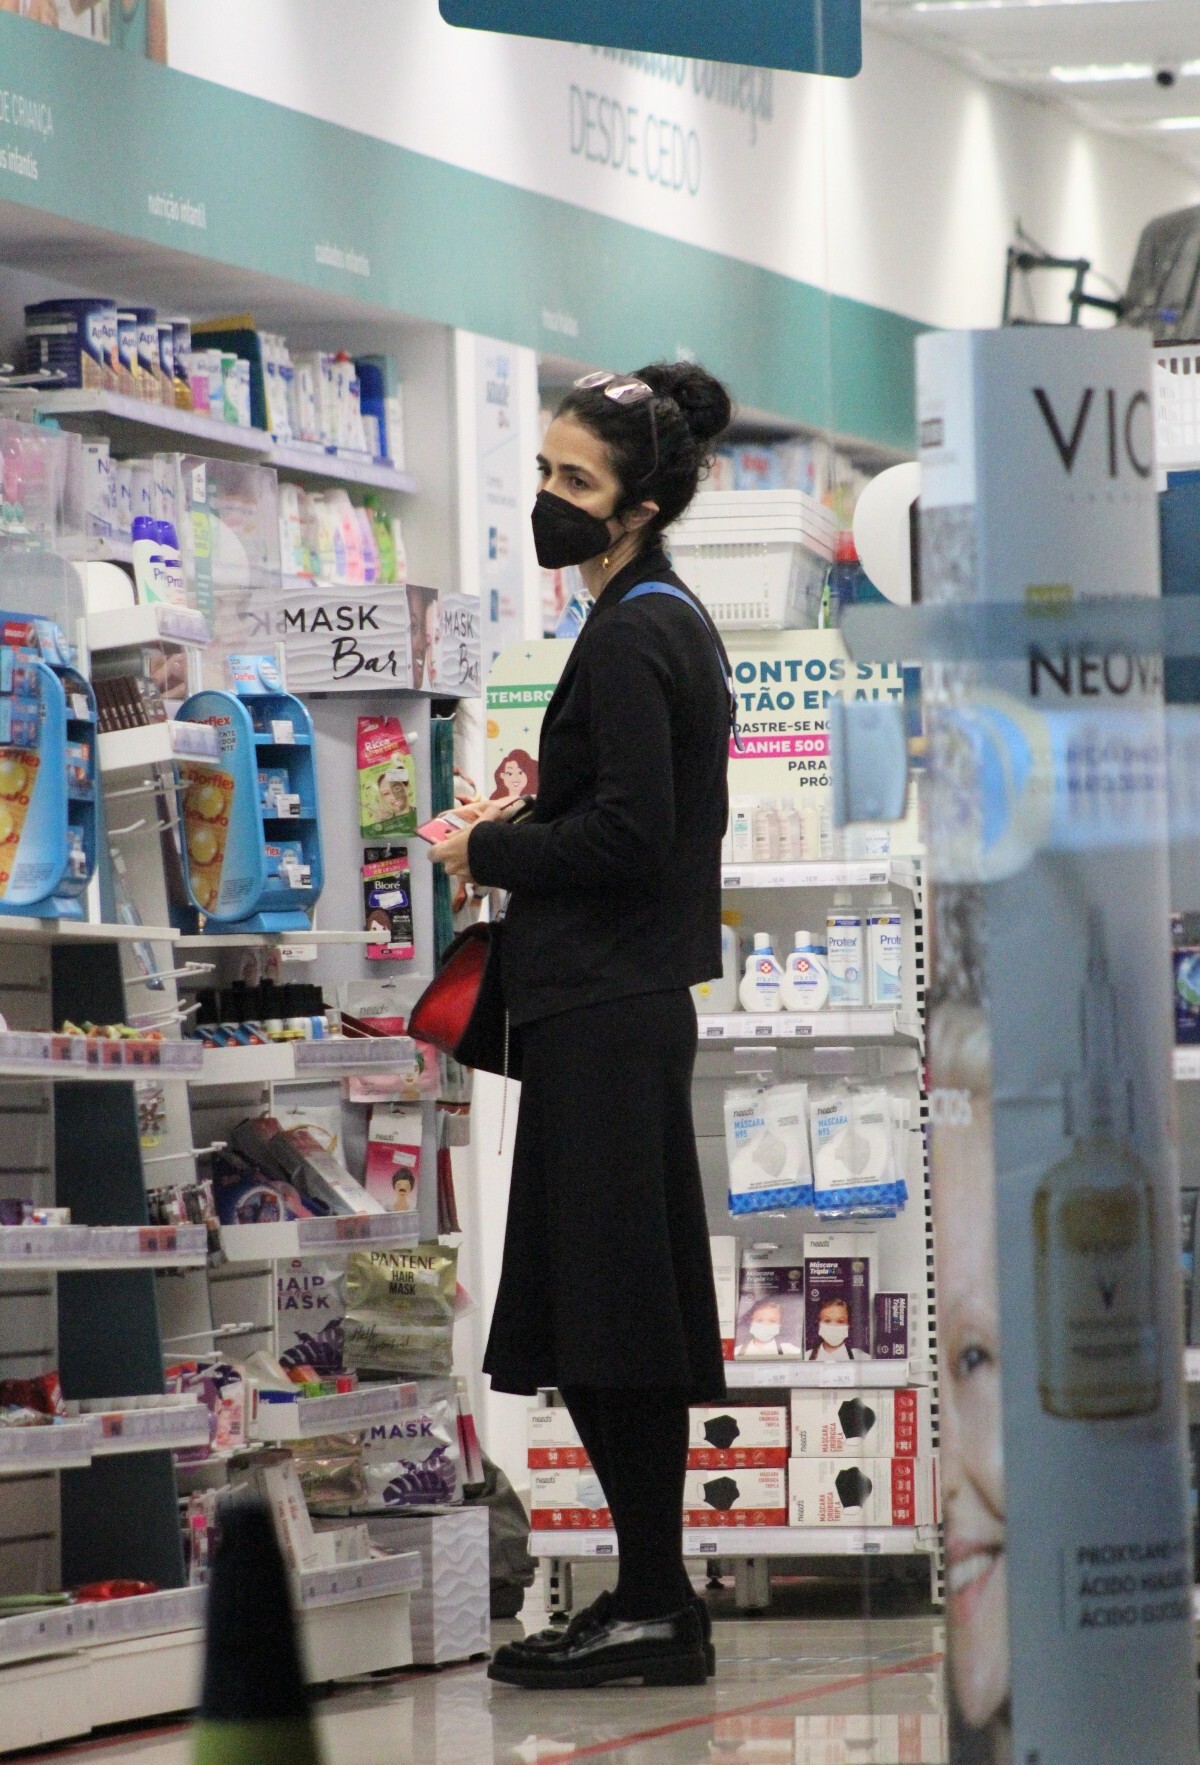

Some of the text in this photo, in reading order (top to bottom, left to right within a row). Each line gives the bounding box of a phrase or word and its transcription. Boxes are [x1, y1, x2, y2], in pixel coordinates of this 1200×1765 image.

[12, 94, 54, 143] CRIANÇA
[569, 82, 701, 198] DESDE CEDO
[284, 605, 379, 632] MASK
[444, 610, 474, 638] MASK
[331, 636, 398, 680] Bar
[734, 739, 825, 754] GANHE 500
[789, 760, 827, 771] PARA
[375, 881, 400, 890] Bioré
[829, 936, 857, 947] Protex
[733, 1107, 755, 1118] needs
[734, 1117, 765, 1130] MÁSCARA
[735, 1129, 748, 1139] N95
[818, 1127, 830, 1137] N95
[370, 1251, 437, 1270] PANTENE
[809, 1261, 839, 1269] Máscara
[392, 1270, 415, 1283] HAIR
[388, 1282, 416, 1296] MASK
[532, 1415, 553, 1423] needs
[370, 1422, 434, 1440] MASK
[535, 1476, 556, 1484] needs
